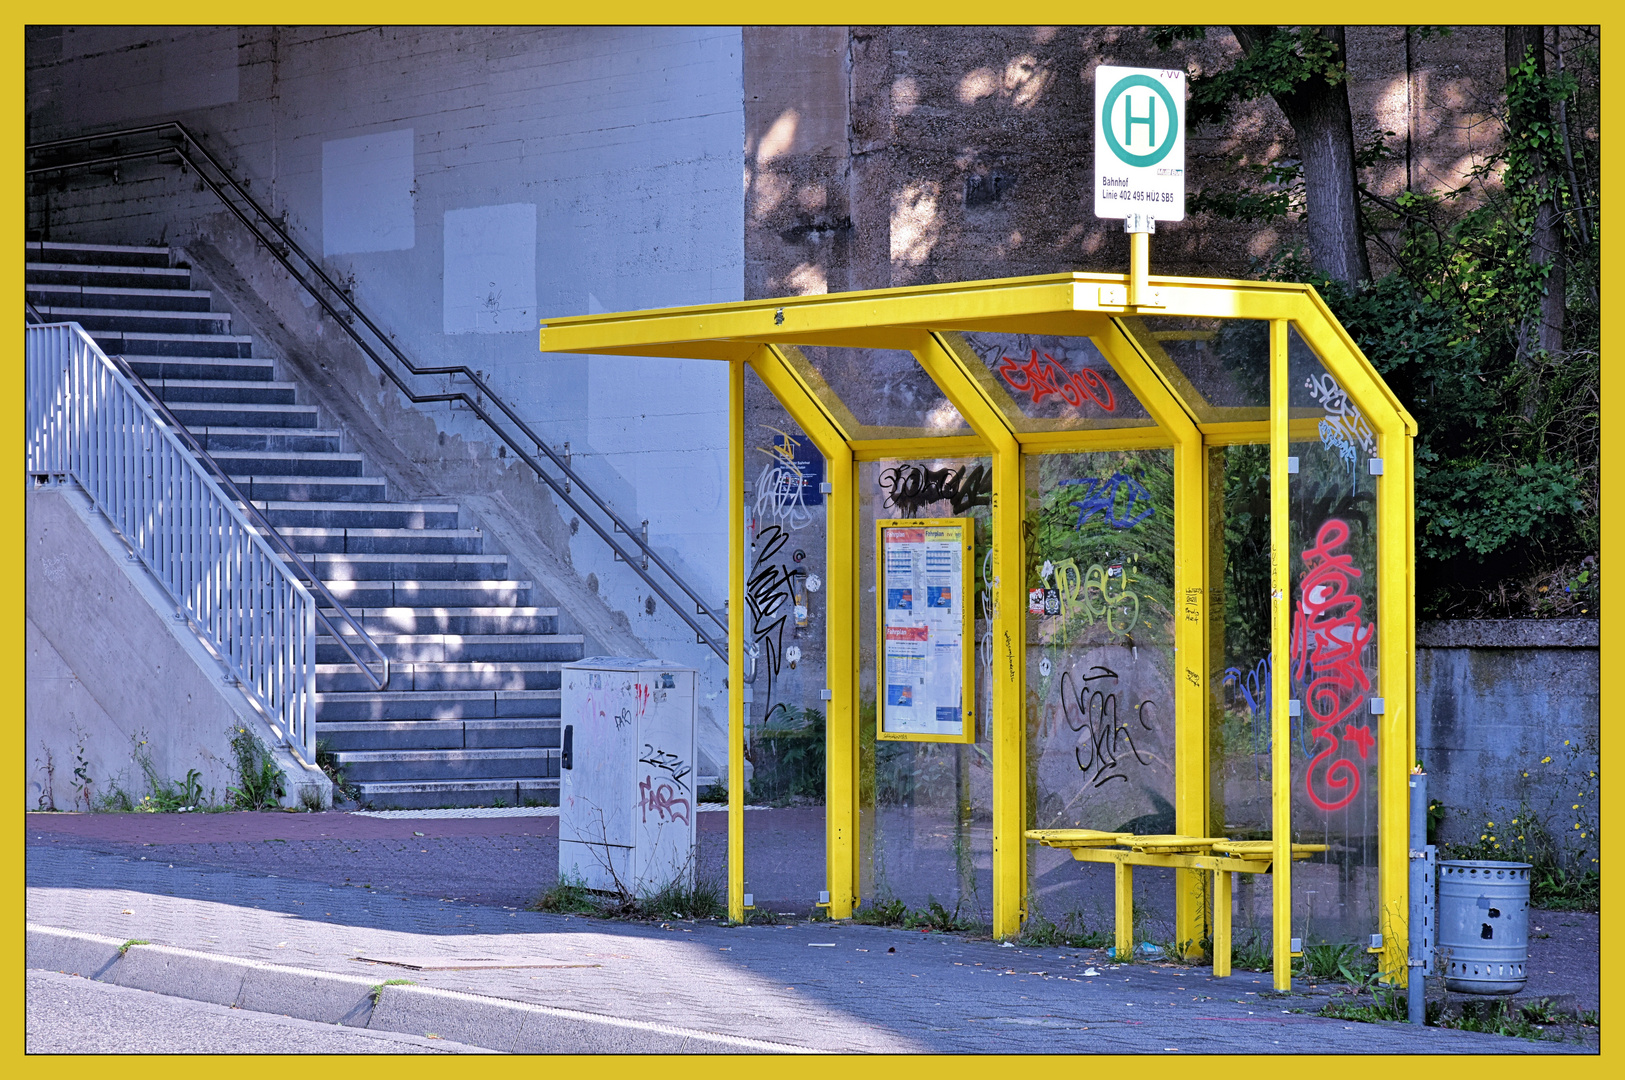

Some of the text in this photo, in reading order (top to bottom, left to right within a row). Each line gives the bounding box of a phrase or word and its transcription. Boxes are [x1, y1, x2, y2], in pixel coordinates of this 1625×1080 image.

[1125, 95, 1155, 147] H
[1102, 176, 1129, 187] Bahnhof
[1102, 189, 1174, 202] Linie 402 495 HÜ2 SB5
[886, 531, 905, 539] Fahrplan
[925, 530, 944, 539] Fahrplan
[887, 628, 907, 636] Fahrplan
